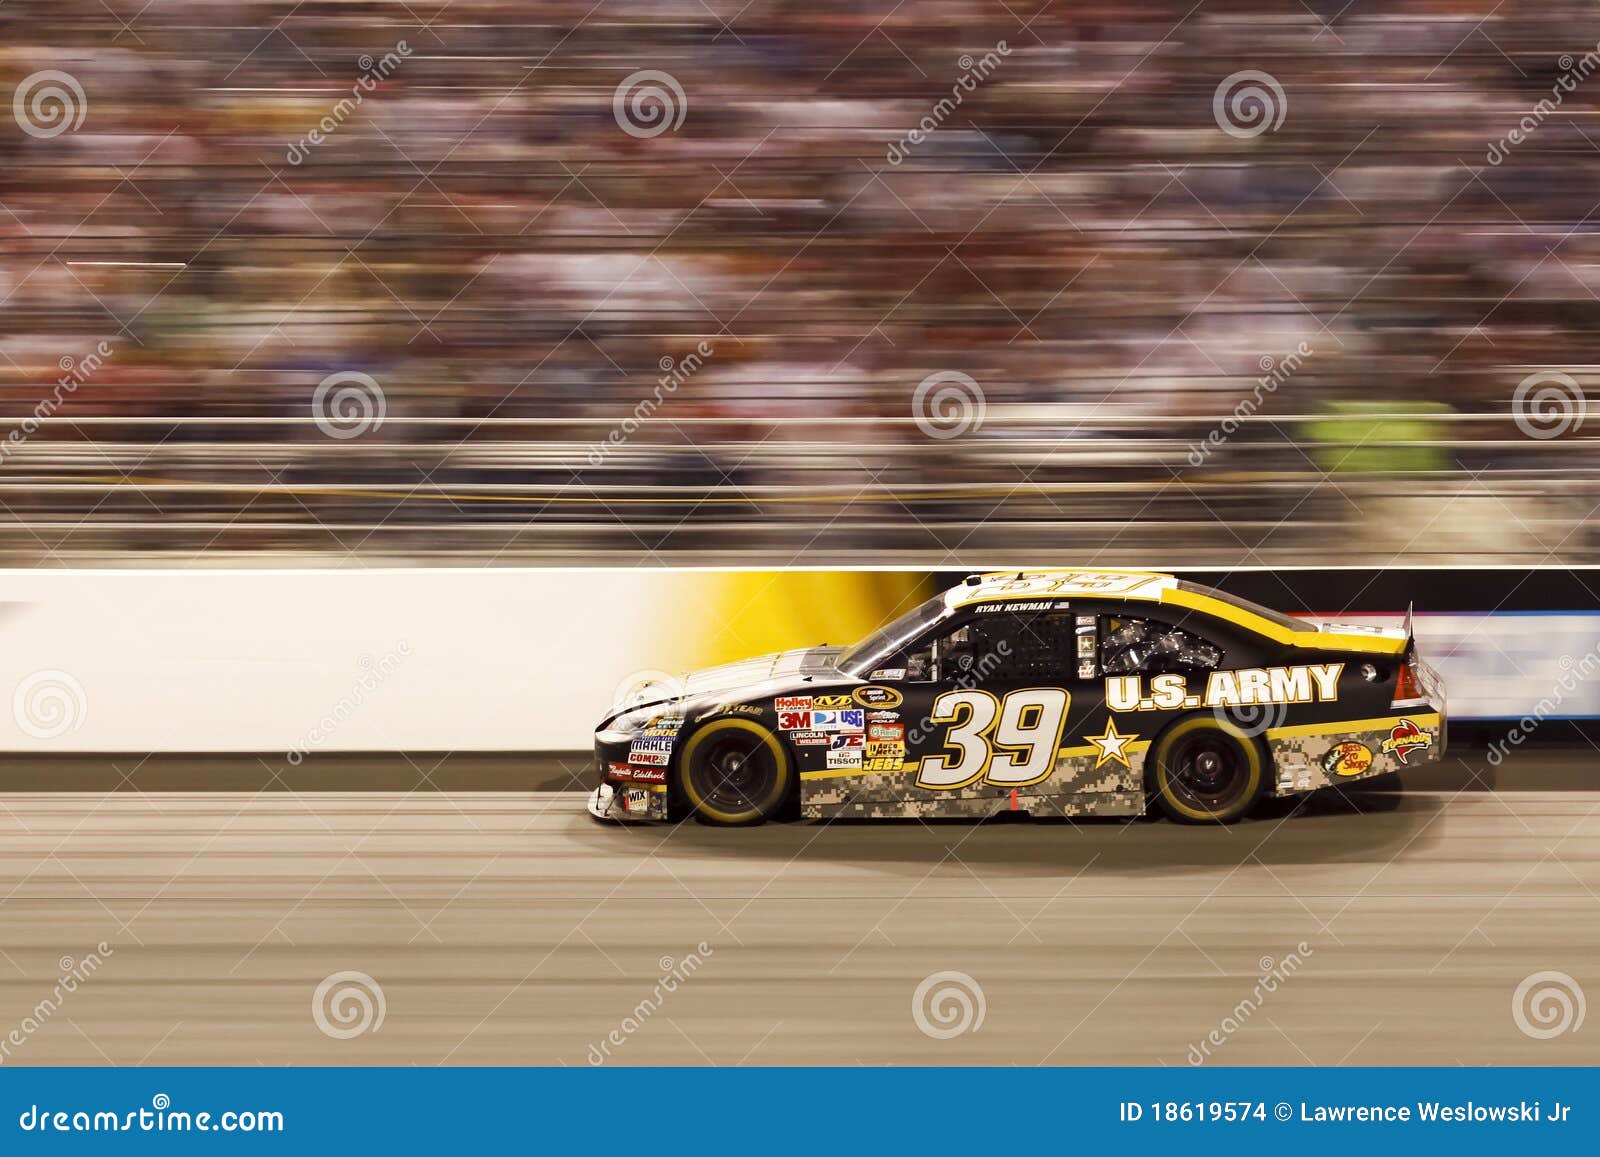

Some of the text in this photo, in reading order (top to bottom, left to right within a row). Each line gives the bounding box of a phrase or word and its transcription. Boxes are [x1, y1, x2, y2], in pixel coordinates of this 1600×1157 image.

[975, 602, 1053, 614] RYAN NEWMAN
[1105, 663, 1346, 713] U.S. ARMY
[775, 697, 812, 709] Holley
[780, 711, 811, 729] 3M
[840, 710, 863, 728] USG
[641, 728, 678, 737] MOOG
[914, 687, 1072, 790] 39
[631, 740, 671, 752] MAHLE
[831, 735, 864, 750] JE
[1341, 743, 1362, 752] Bass
[629, 753, 660, 762] COMP
[828, 757, 861, 765] TISSOT
[1344, 752, 1359, 761] Pro
[862, 757, 905, 770] JEGS
[1344, 759, 1369, 770] Shops
[629, 790, 646, 802] WIX
